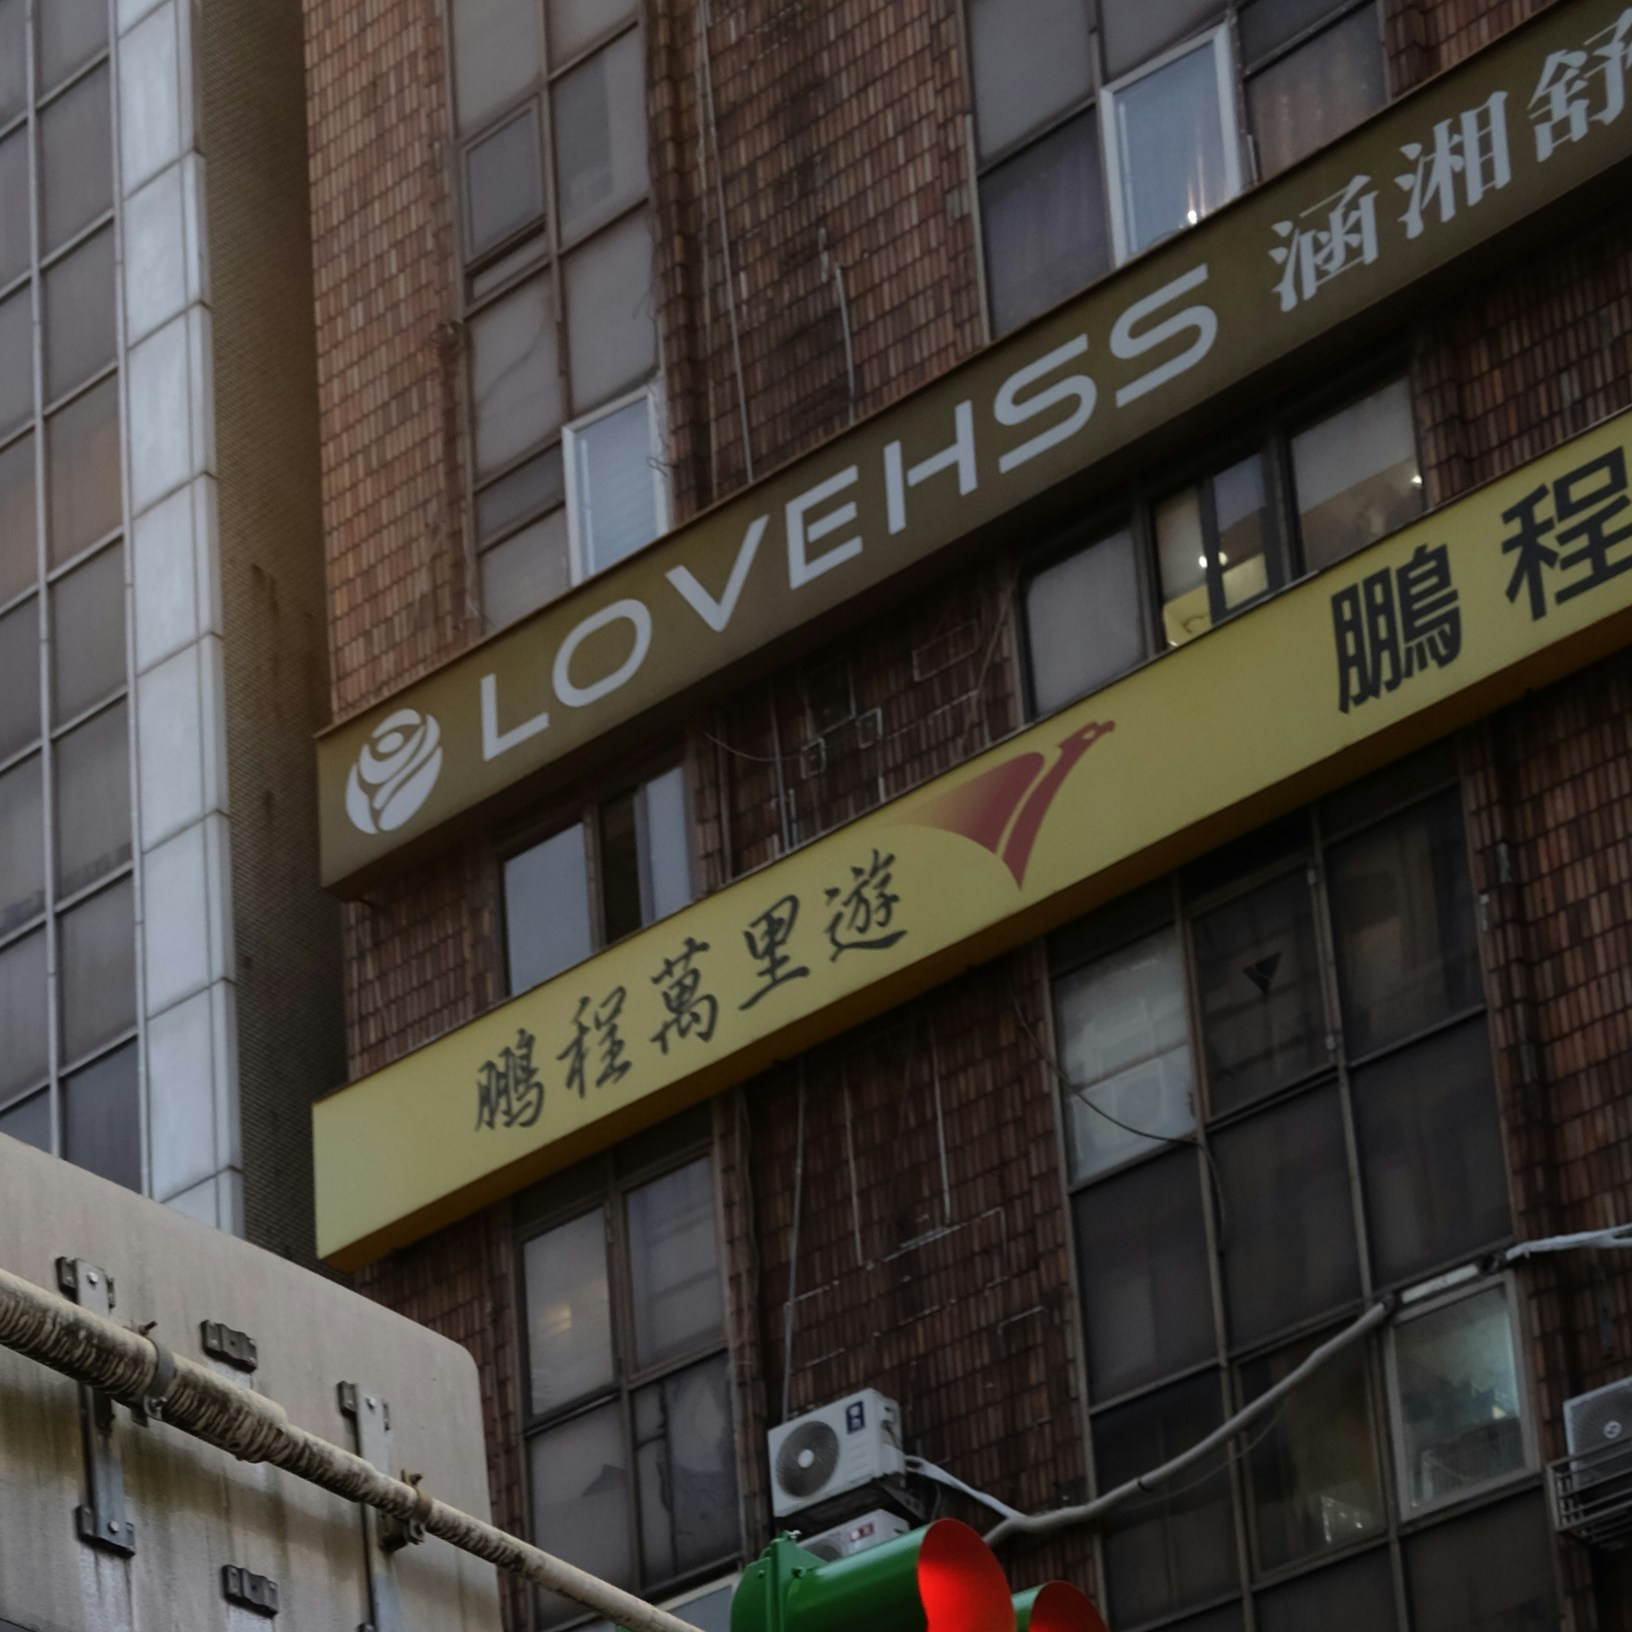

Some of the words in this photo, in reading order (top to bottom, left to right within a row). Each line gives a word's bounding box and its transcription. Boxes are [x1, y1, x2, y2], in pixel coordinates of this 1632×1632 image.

[479, 266, 1217, 762] LOVEHSS
[1333, 445, 1632, 716] 鵬程
[474, 847, 908, 1134] 鵬程萬里遊
